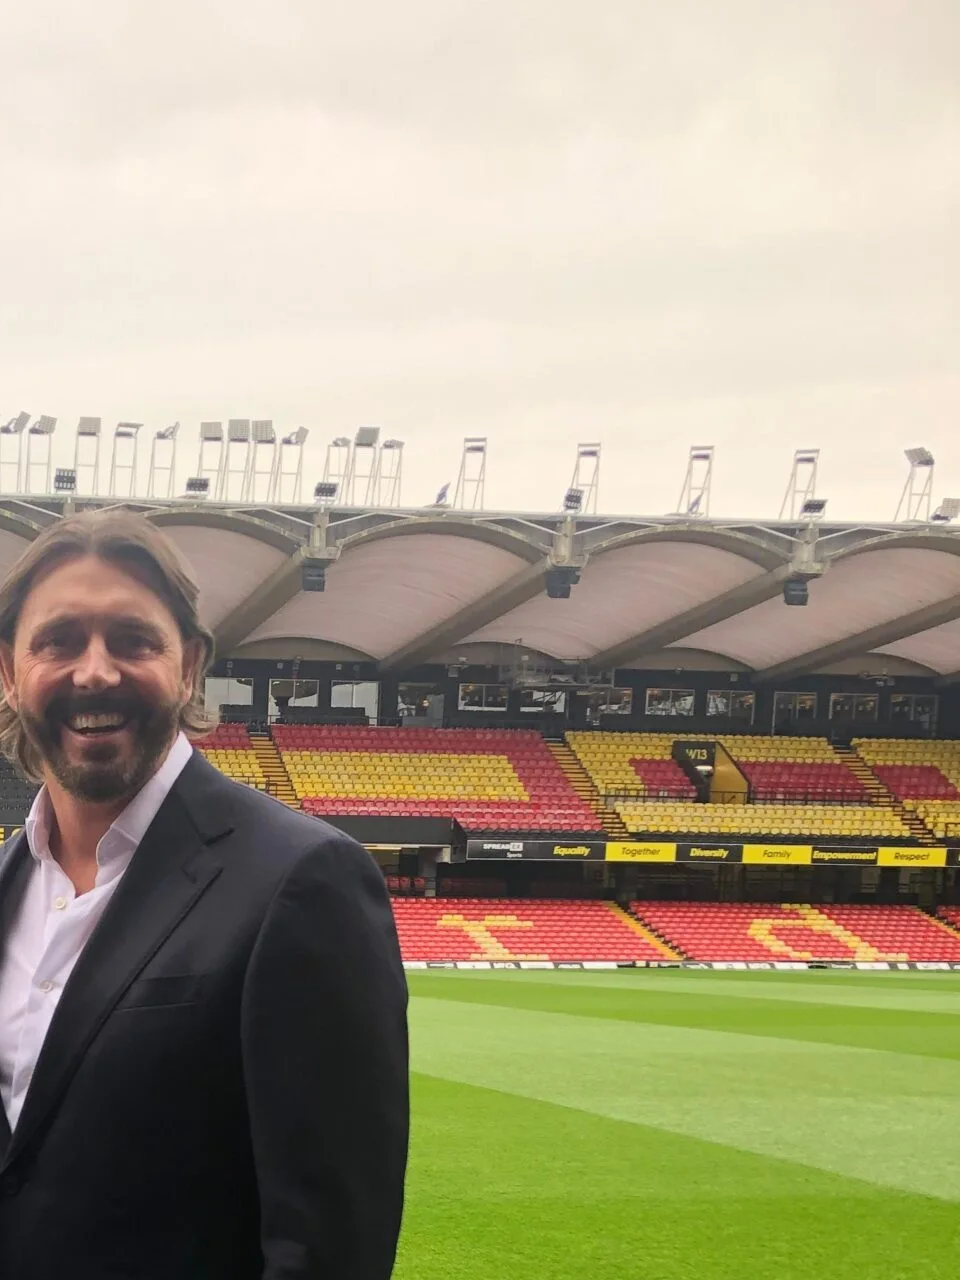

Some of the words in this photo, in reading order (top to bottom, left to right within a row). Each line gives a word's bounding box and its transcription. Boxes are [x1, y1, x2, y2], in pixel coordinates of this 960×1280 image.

[685, 748, 708, 760] W13
[553, 846, 591, 856] Equality
[621, 847, 661, 857] Together
[690, 848, 729, 858] Diversity
[762, 849, 792, 860] Family
[812, 850, 877, 861] Empowerment
[893, 851, 931, 862] Respect
